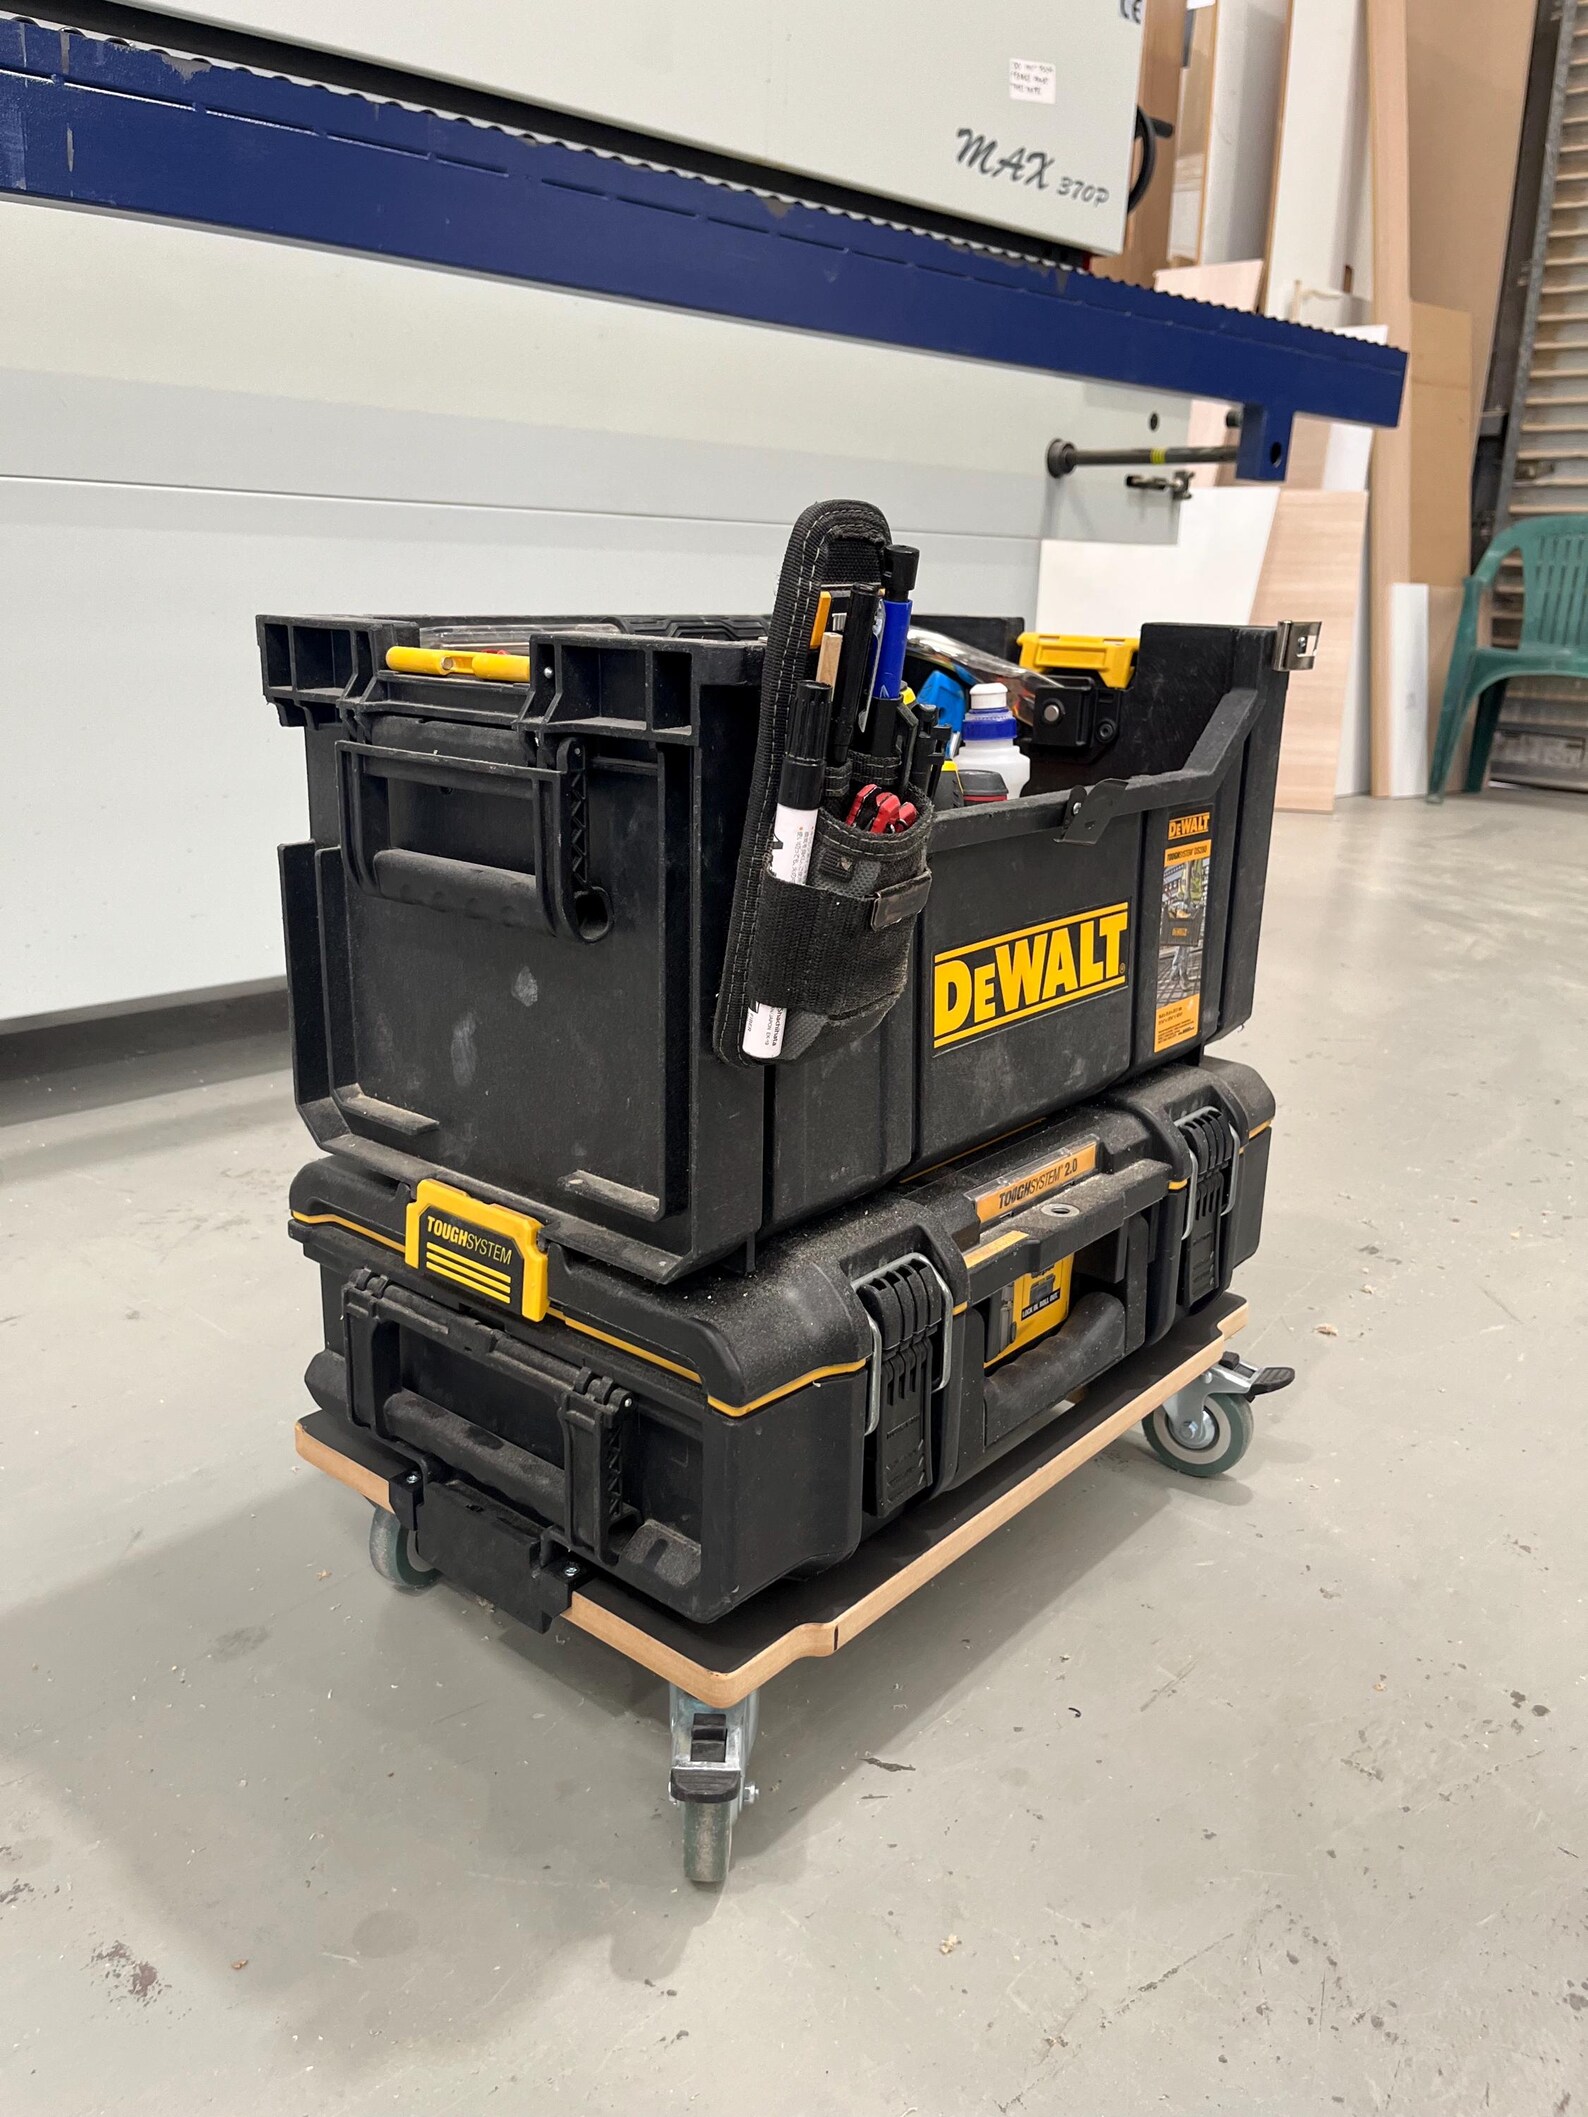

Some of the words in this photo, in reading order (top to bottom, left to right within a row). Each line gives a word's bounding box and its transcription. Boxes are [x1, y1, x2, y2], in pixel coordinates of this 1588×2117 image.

[956, 128, 1055, 190] MAX
[1057, 177, 1110, 207] 370P
[1168, 815, 1210, 837] DEWALT
[934, 911, 1128, 1038] DEWALT
[1064, 1158, 1078, 1177] 2.0
[427, 1215, 513, 1265] TOUGHSYSTEM
